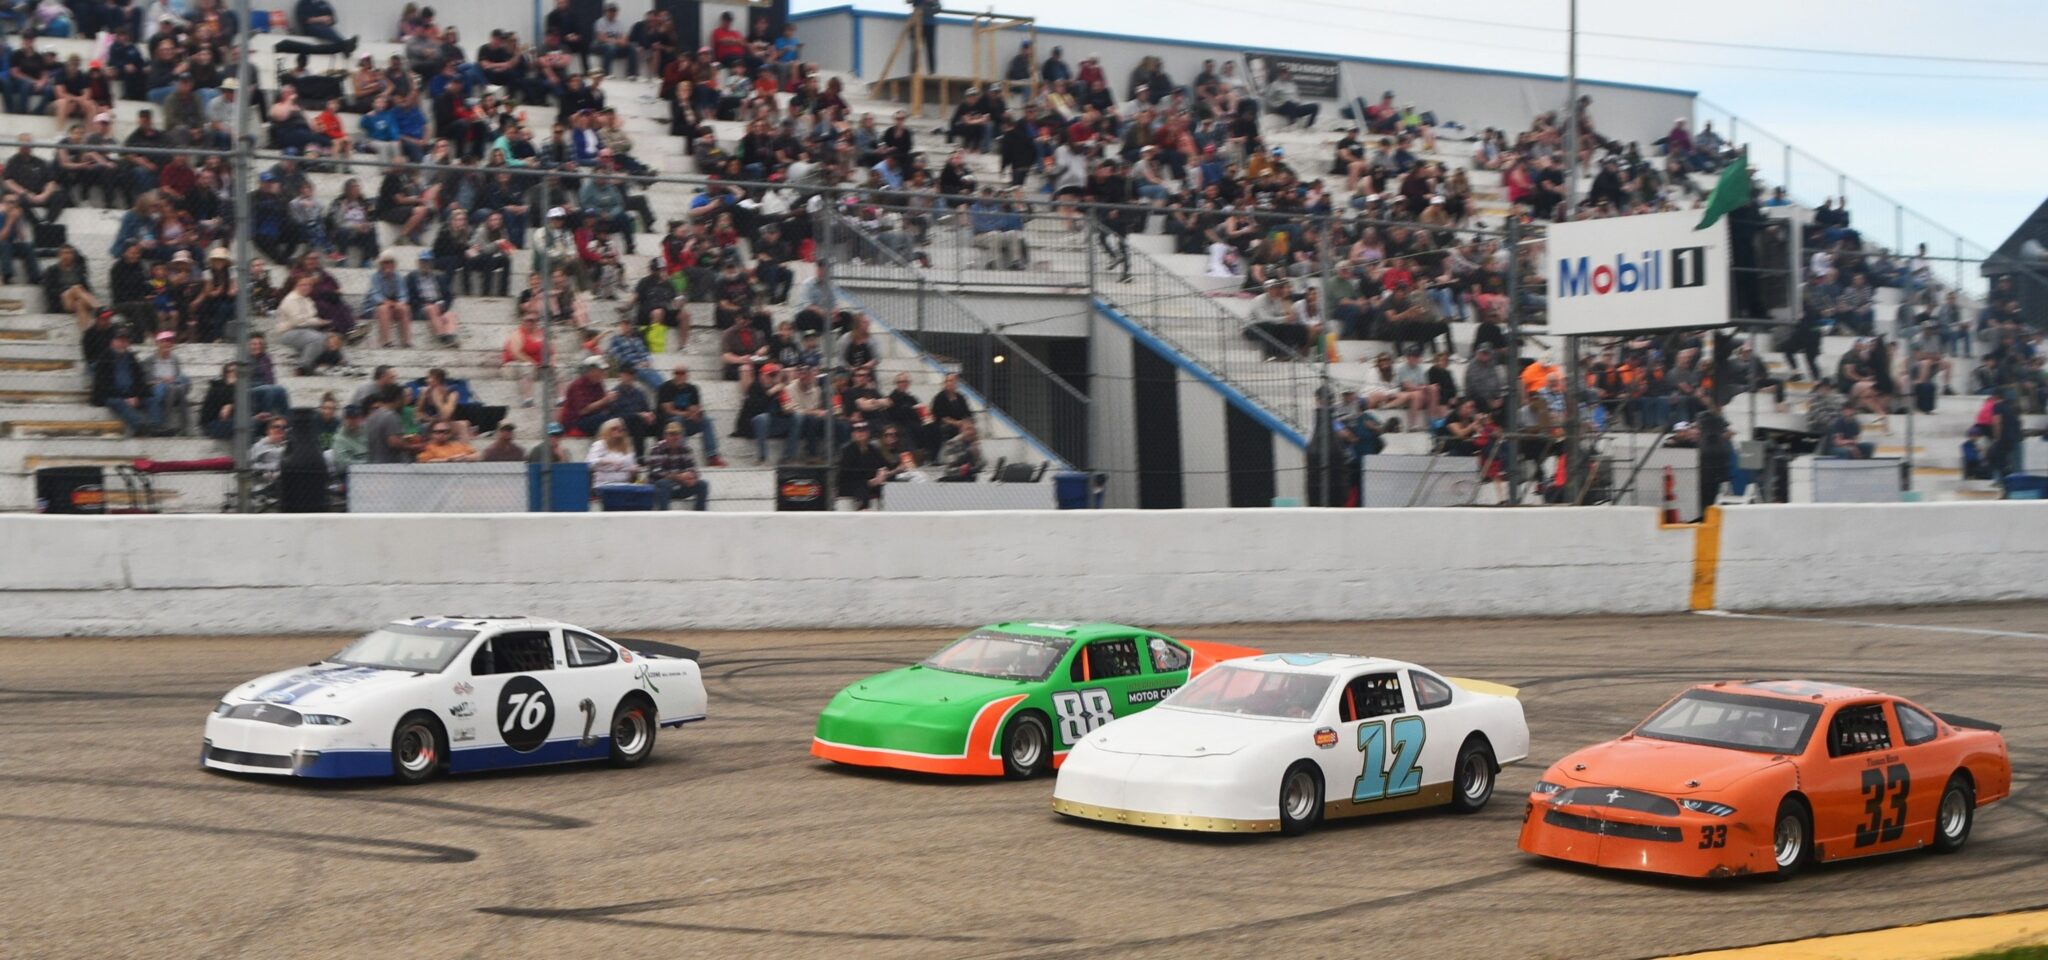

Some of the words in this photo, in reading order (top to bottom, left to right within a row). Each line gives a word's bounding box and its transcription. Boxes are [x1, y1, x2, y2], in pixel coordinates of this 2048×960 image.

[1559, 250, 1661, 297] Mobil
[1675, 248, 1700, 287] 1
[503, 690, 546, 733] 76
[1052, 688, 1115, 746] 88
[1129, 690, 1159, 702] MOTOR
[1352, 715, 1426, 803] 12
[1854, 763, 1910, 848] 33
[1698, 824, 1728, 849] 33
